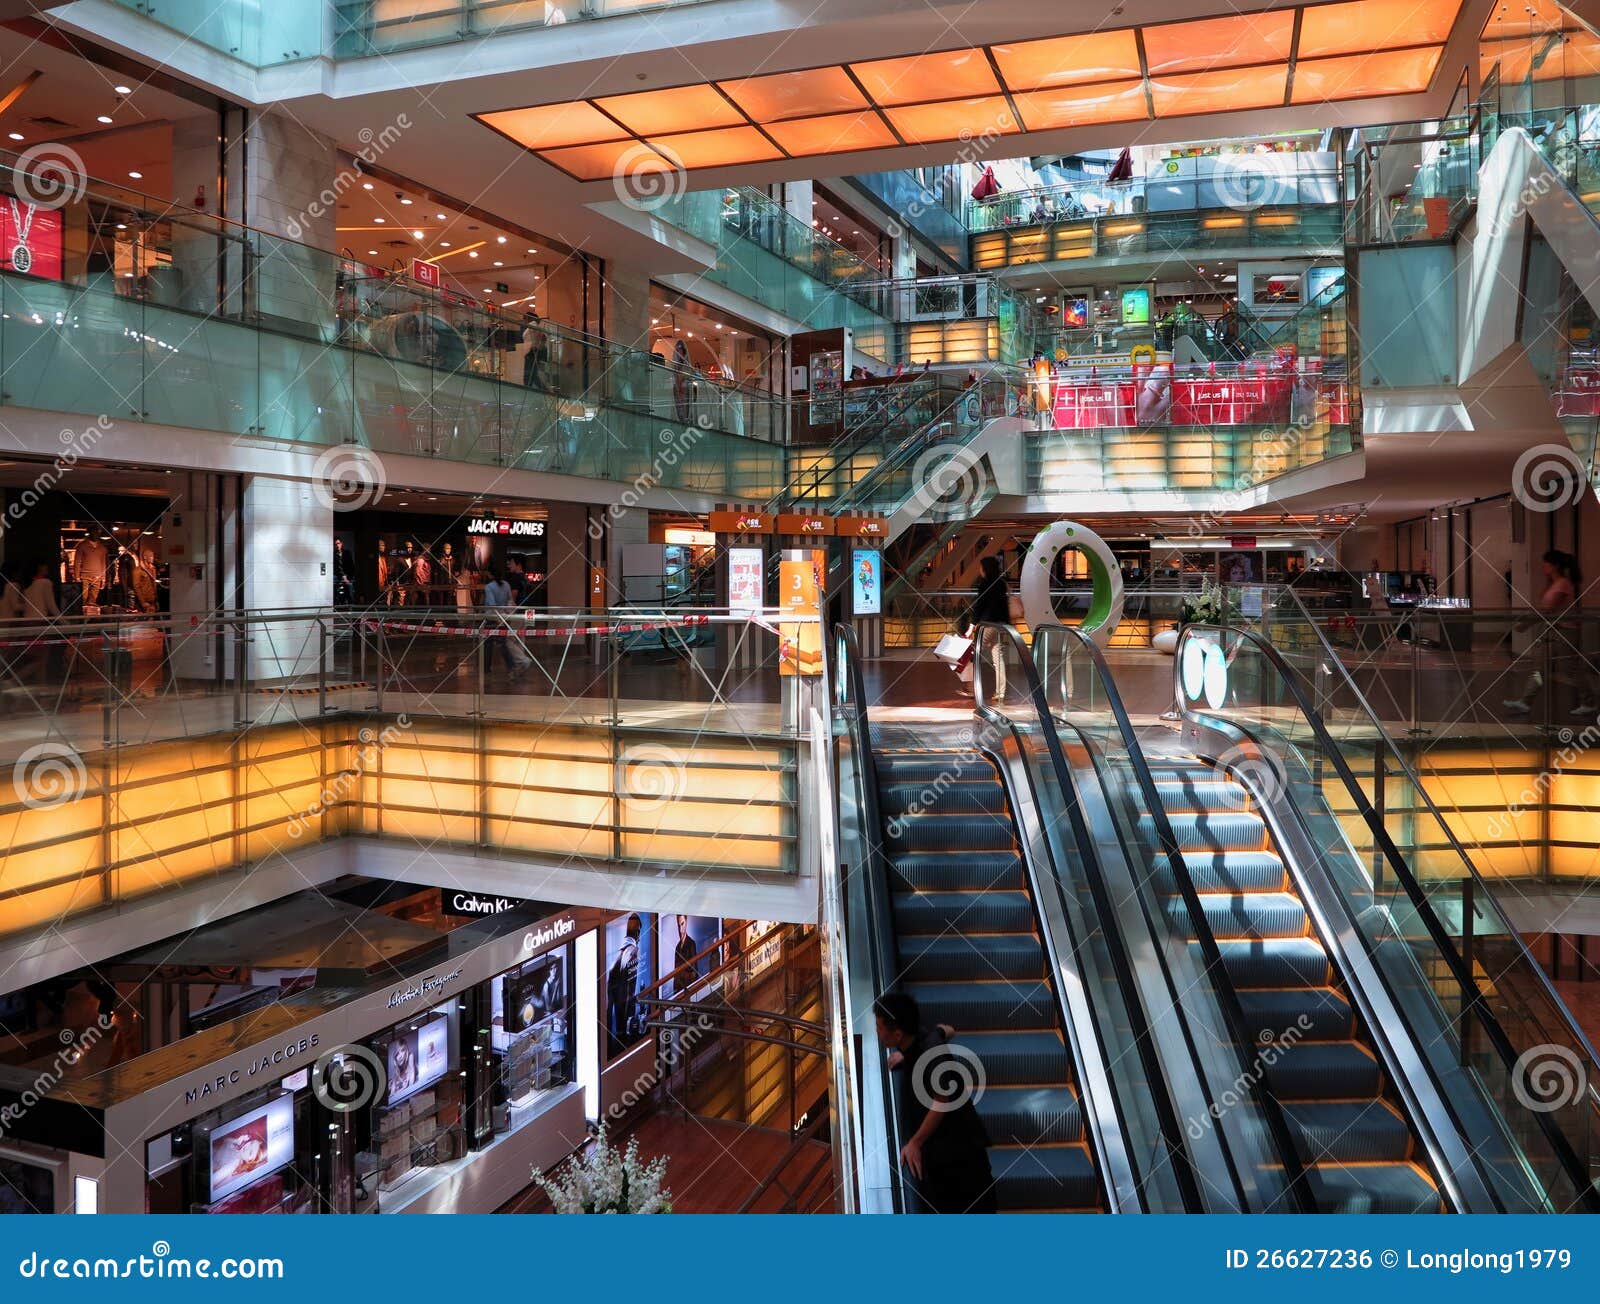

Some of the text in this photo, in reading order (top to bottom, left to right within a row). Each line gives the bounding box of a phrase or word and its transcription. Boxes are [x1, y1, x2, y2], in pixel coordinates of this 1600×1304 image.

[467, 519, 544, 536] JACK JONES
[595, 574, 600, 584] 3
[792, 573, 802, 590] 3
[453, 894, 494, 914] Calvin
[523, 915, 576, 951] Calvin Klein
[185, 1033, 320, 1105] MARC JACOBS
